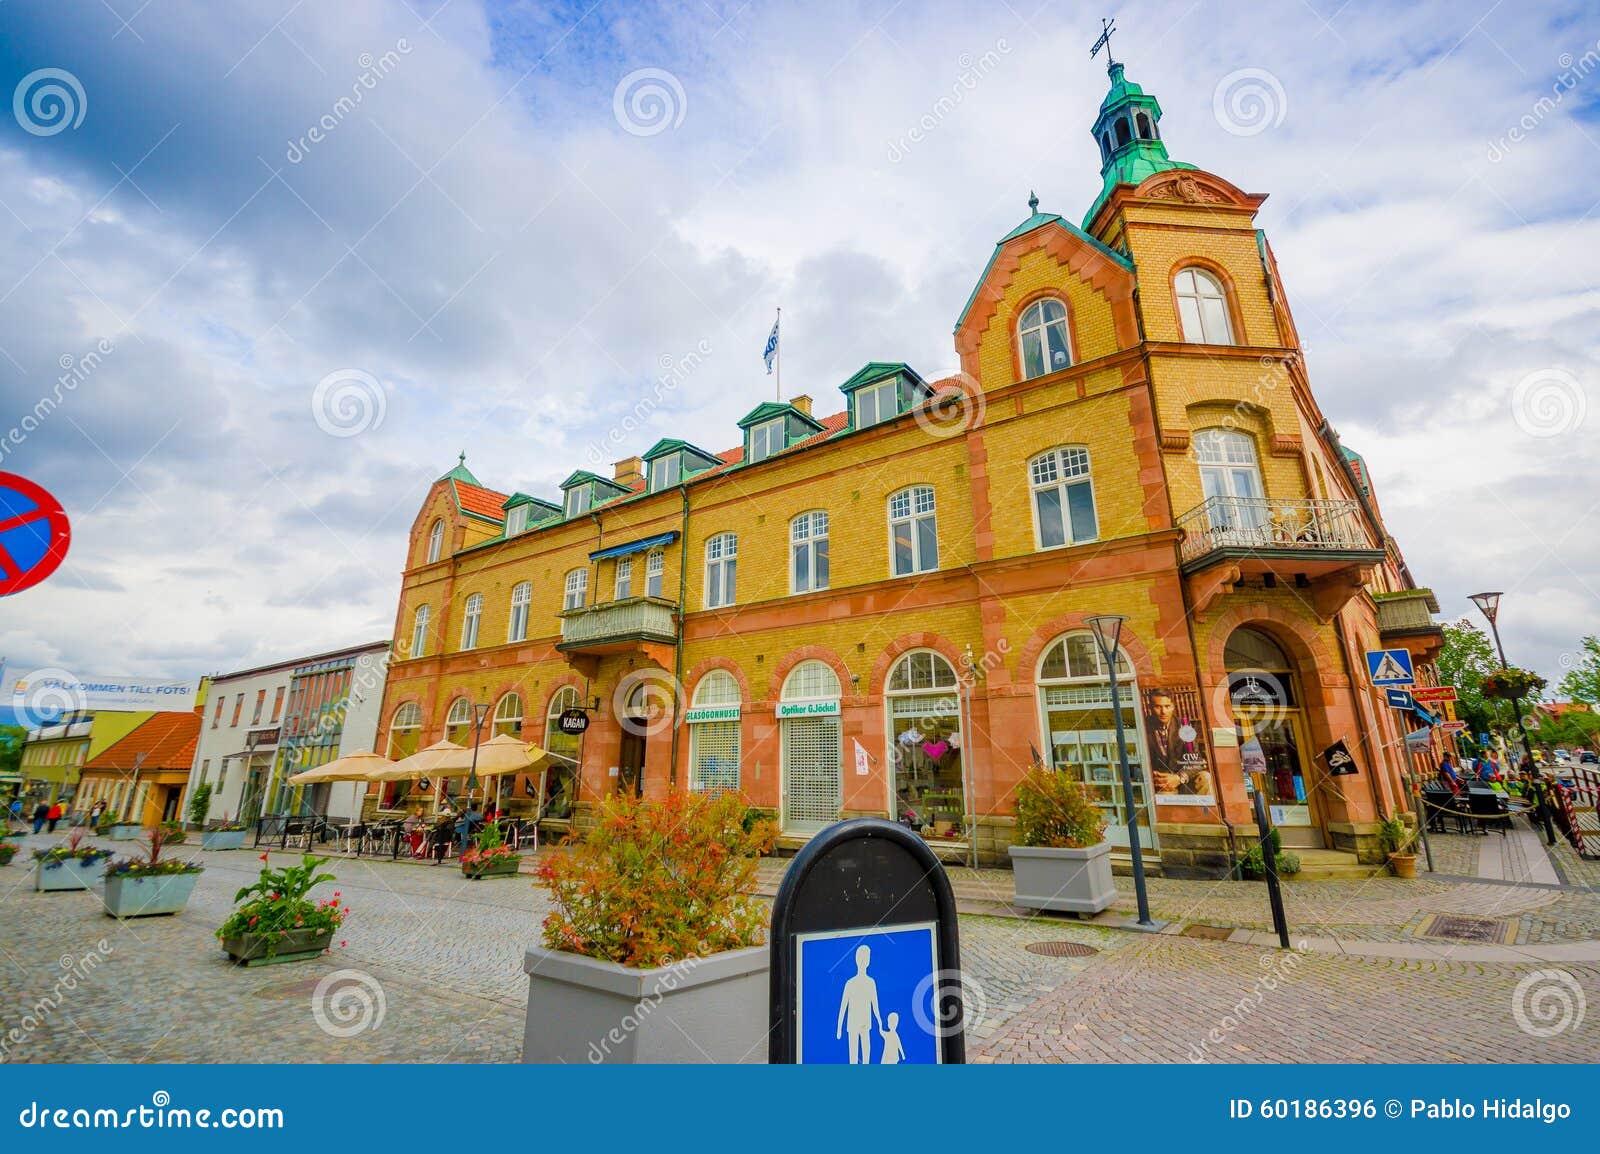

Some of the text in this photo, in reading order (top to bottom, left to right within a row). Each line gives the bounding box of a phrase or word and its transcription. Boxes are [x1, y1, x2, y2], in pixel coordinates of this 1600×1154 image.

[129, 685, 153, 694] TILL
[156, 686, 191, 695] FOTS!
[686, 709, 740, 721] GLASÖGONHUSET
[781, 704, 806, 716] Optiker
[563, 717, 586, 729] KAGAN
